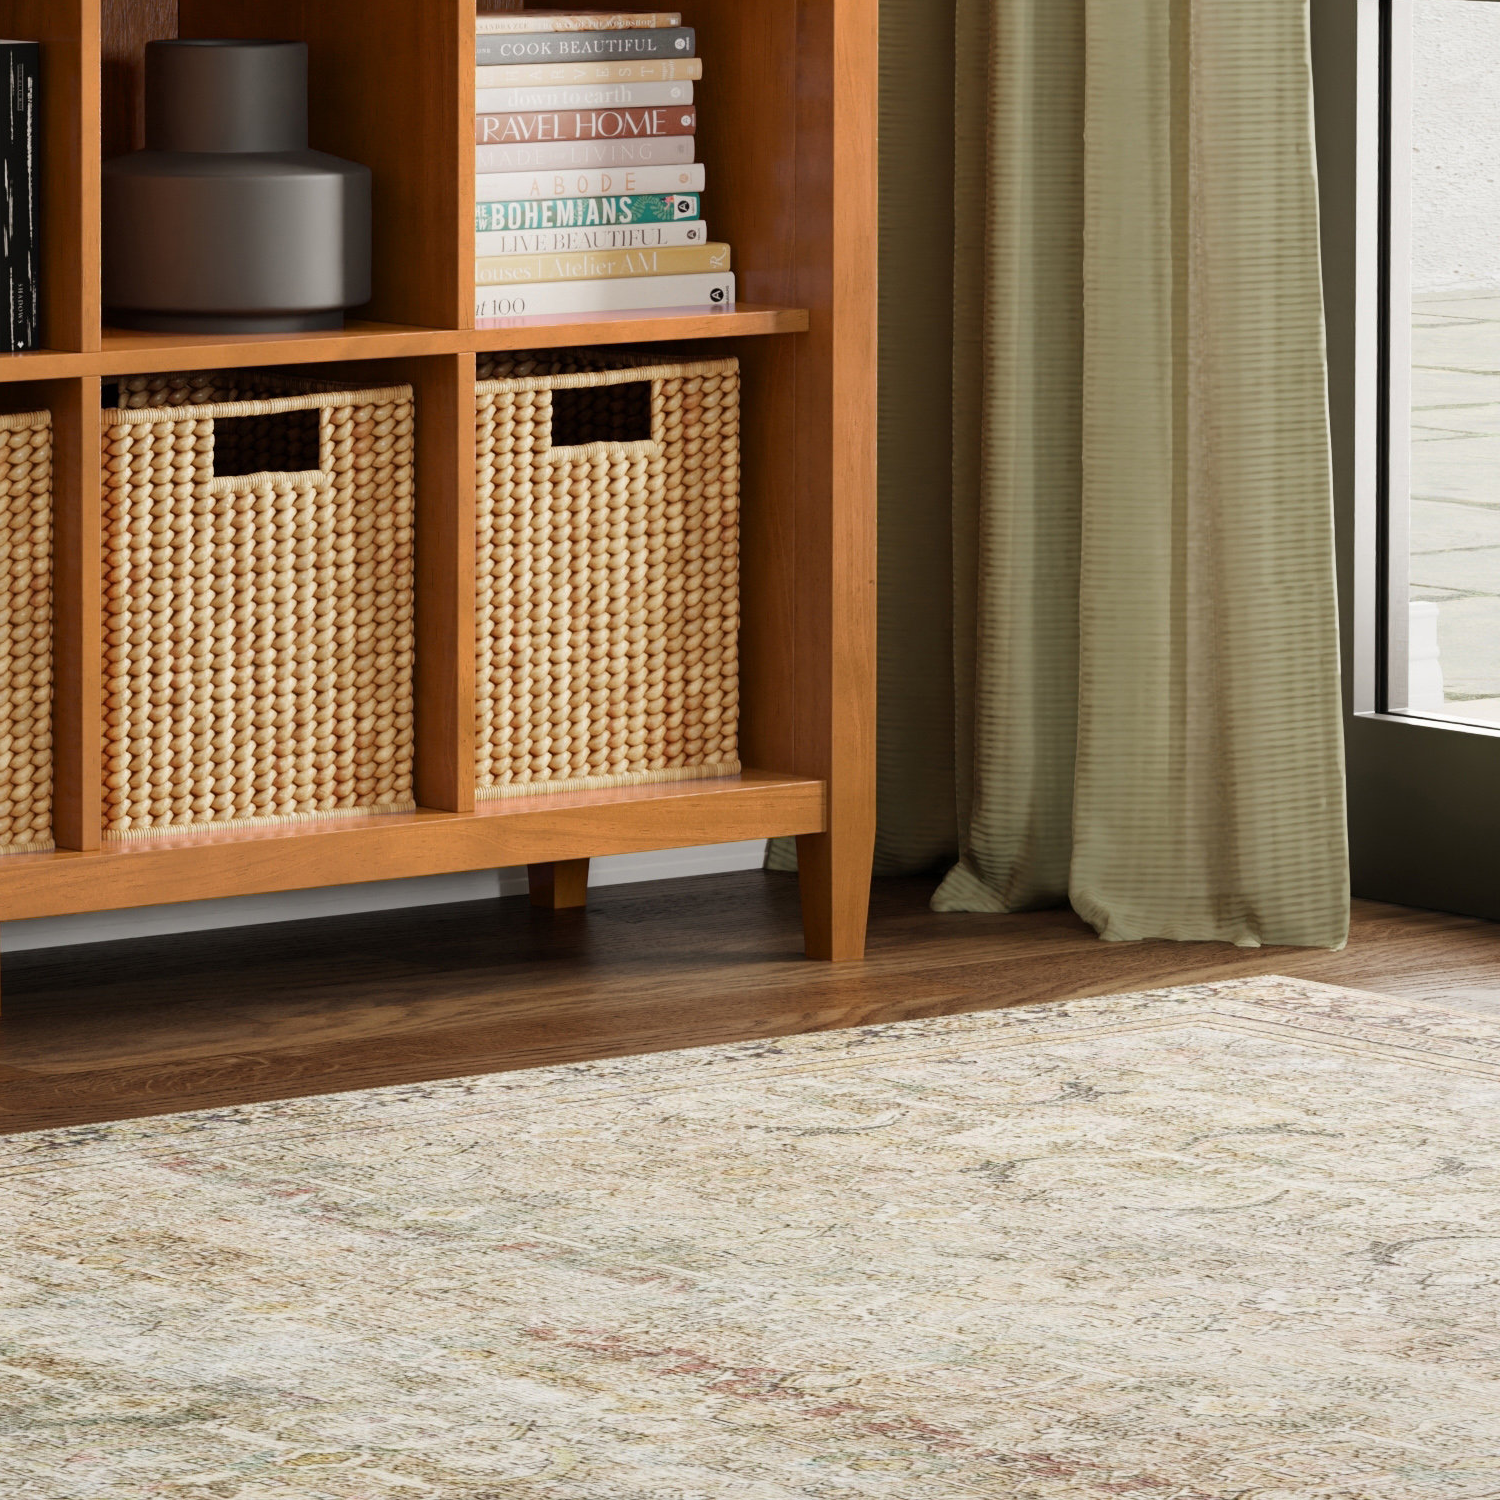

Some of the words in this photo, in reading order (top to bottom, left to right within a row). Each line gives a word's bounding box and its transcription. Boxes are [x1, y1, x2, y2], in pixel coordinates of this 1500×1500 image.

[500, 42, 552, 57] COOK
[559, 38, 657, 54] BEAUTIFUL
[508, 86, 558, 107] down
[563, 91, 581, 104] to
[584, 84, 632, 104] earth
[575, 109, 667, 138] HOME
[571, 143, 653, 163] LIVING
[529, 172, 636, 196] ABODE
[491, 196, 633, 230] BOHEMIANS
[501, 233, 547, 252] LIVE
[553, 228, 668, 250] BEAUTIFUL
[548, 254, 616, 278] Atelier
[619, 251, 658, 274] AM
[493, 297, 526, 316] 100
